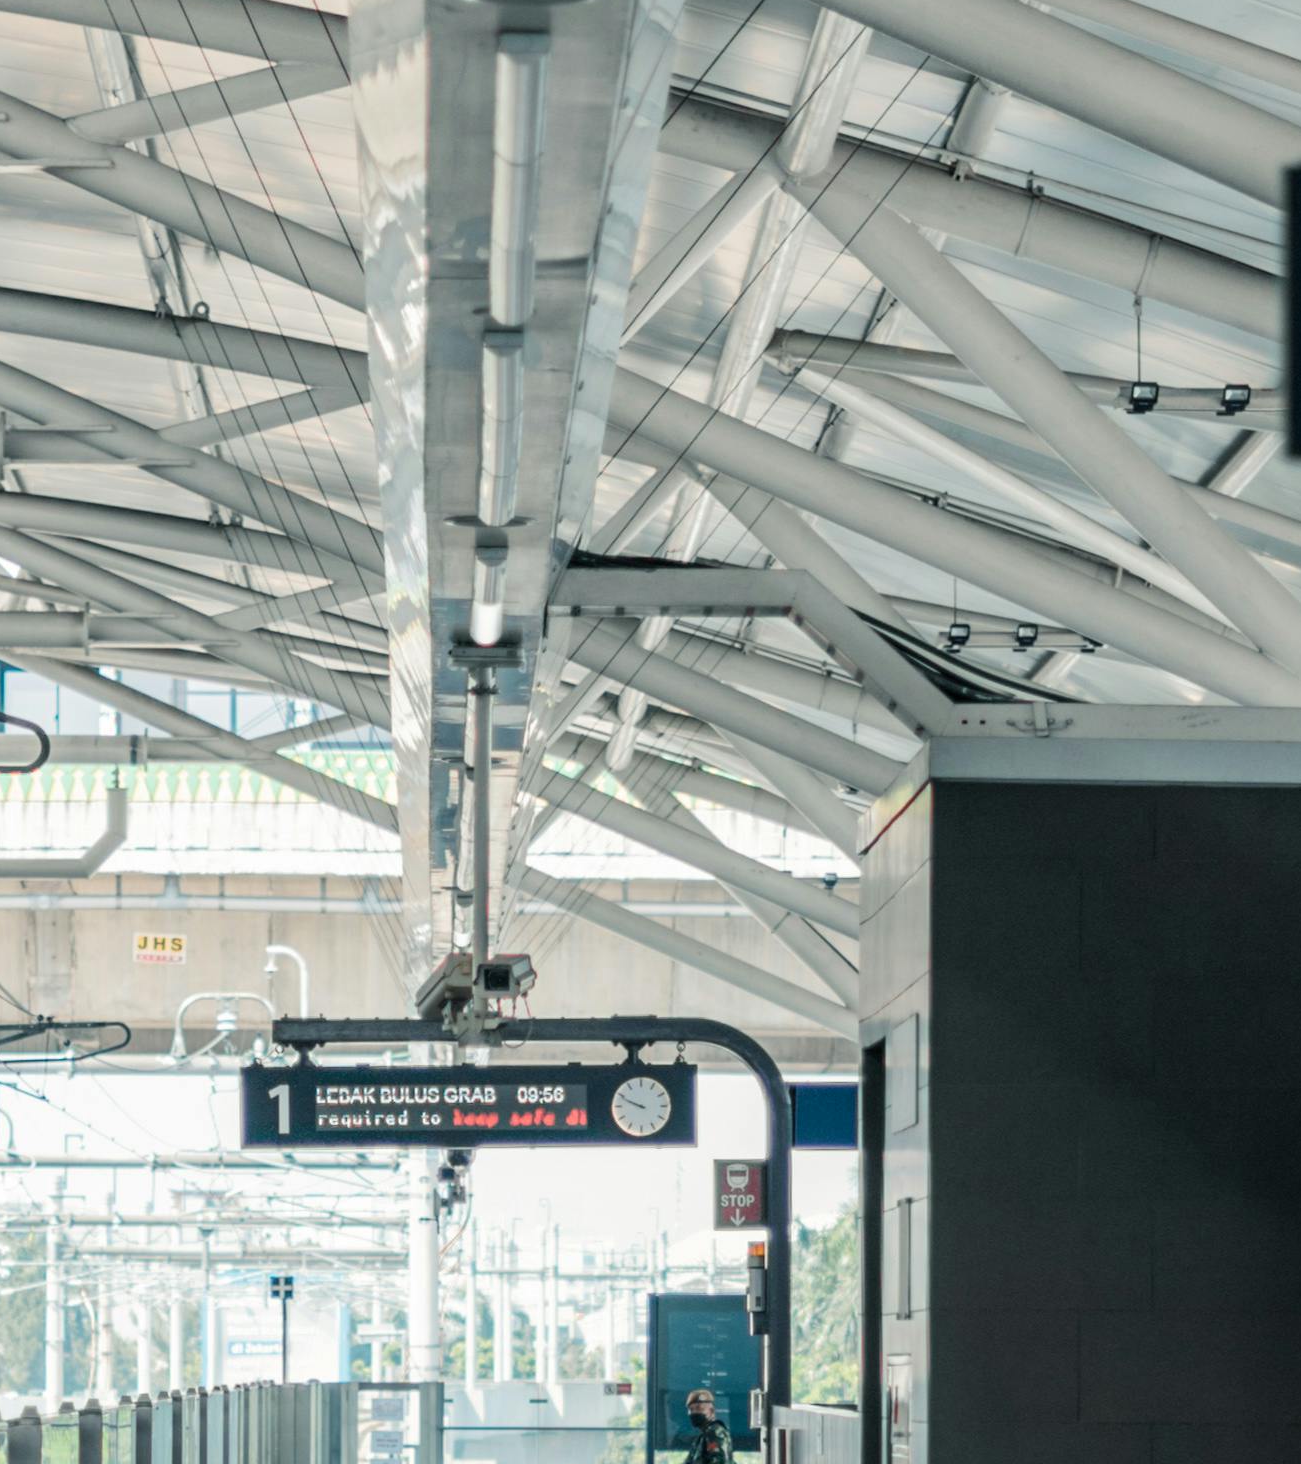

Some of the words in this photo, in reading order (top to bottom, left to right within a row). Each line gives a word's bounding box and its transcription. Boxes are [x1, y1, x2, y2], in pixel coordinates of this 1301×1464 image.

[137, 936, 183, 952] JHS
[380, 1087, 439, 1104] BULUS
[443, 1087, 497, 1103] GRAB
[517, 1087, 565, 1104] 09:56
[268, 1084, 290, 1135] 1
[318, 1109, 409, 1128] required
[421, 1111, 442, 1125] to
[509, 1107, 556, 1126] safe
[720, 1194, 755, 1208] STOP
